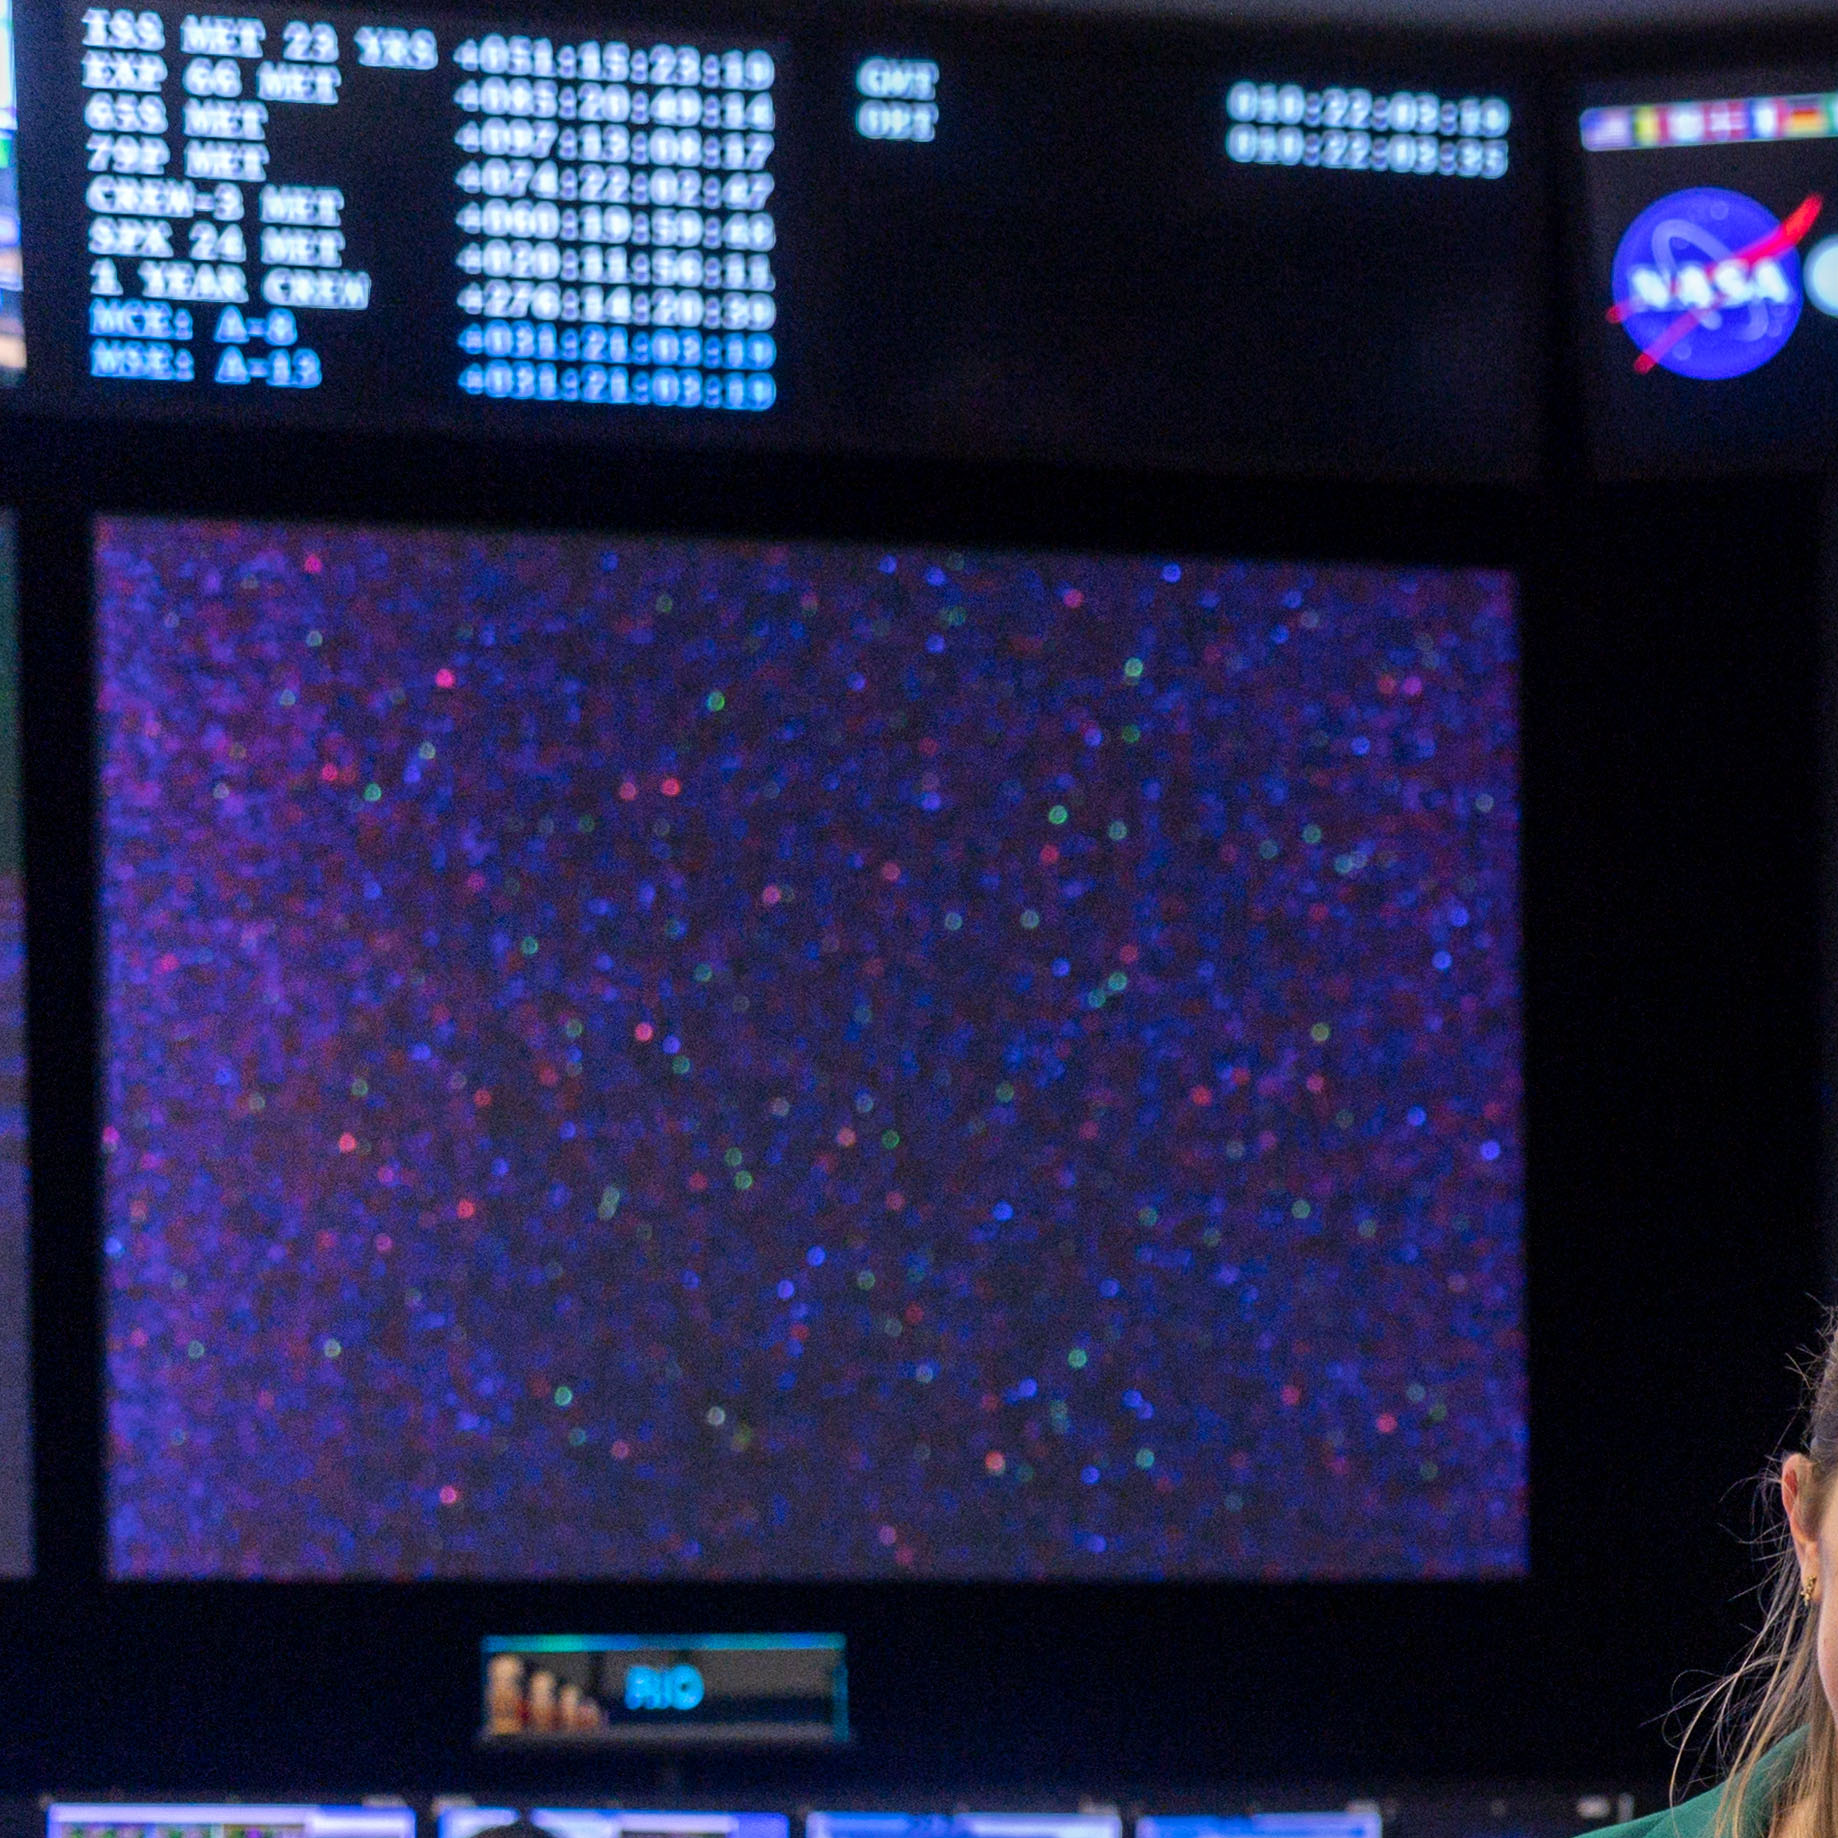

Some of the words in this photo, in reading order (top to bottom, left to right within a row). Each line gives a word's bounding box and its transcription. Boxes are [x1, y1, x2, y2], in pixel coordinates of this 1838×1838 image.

[82, 8, 166, 51] ISS
[282, 21, 339, 63] 23
[182, 57, 242, 98] 66
[189, 220, 247, 262] 24
[137, 260, 249, 303] YEAR
[262, 267, 372, 310] CREW
[1630, 258, 1794, 311] NASA
